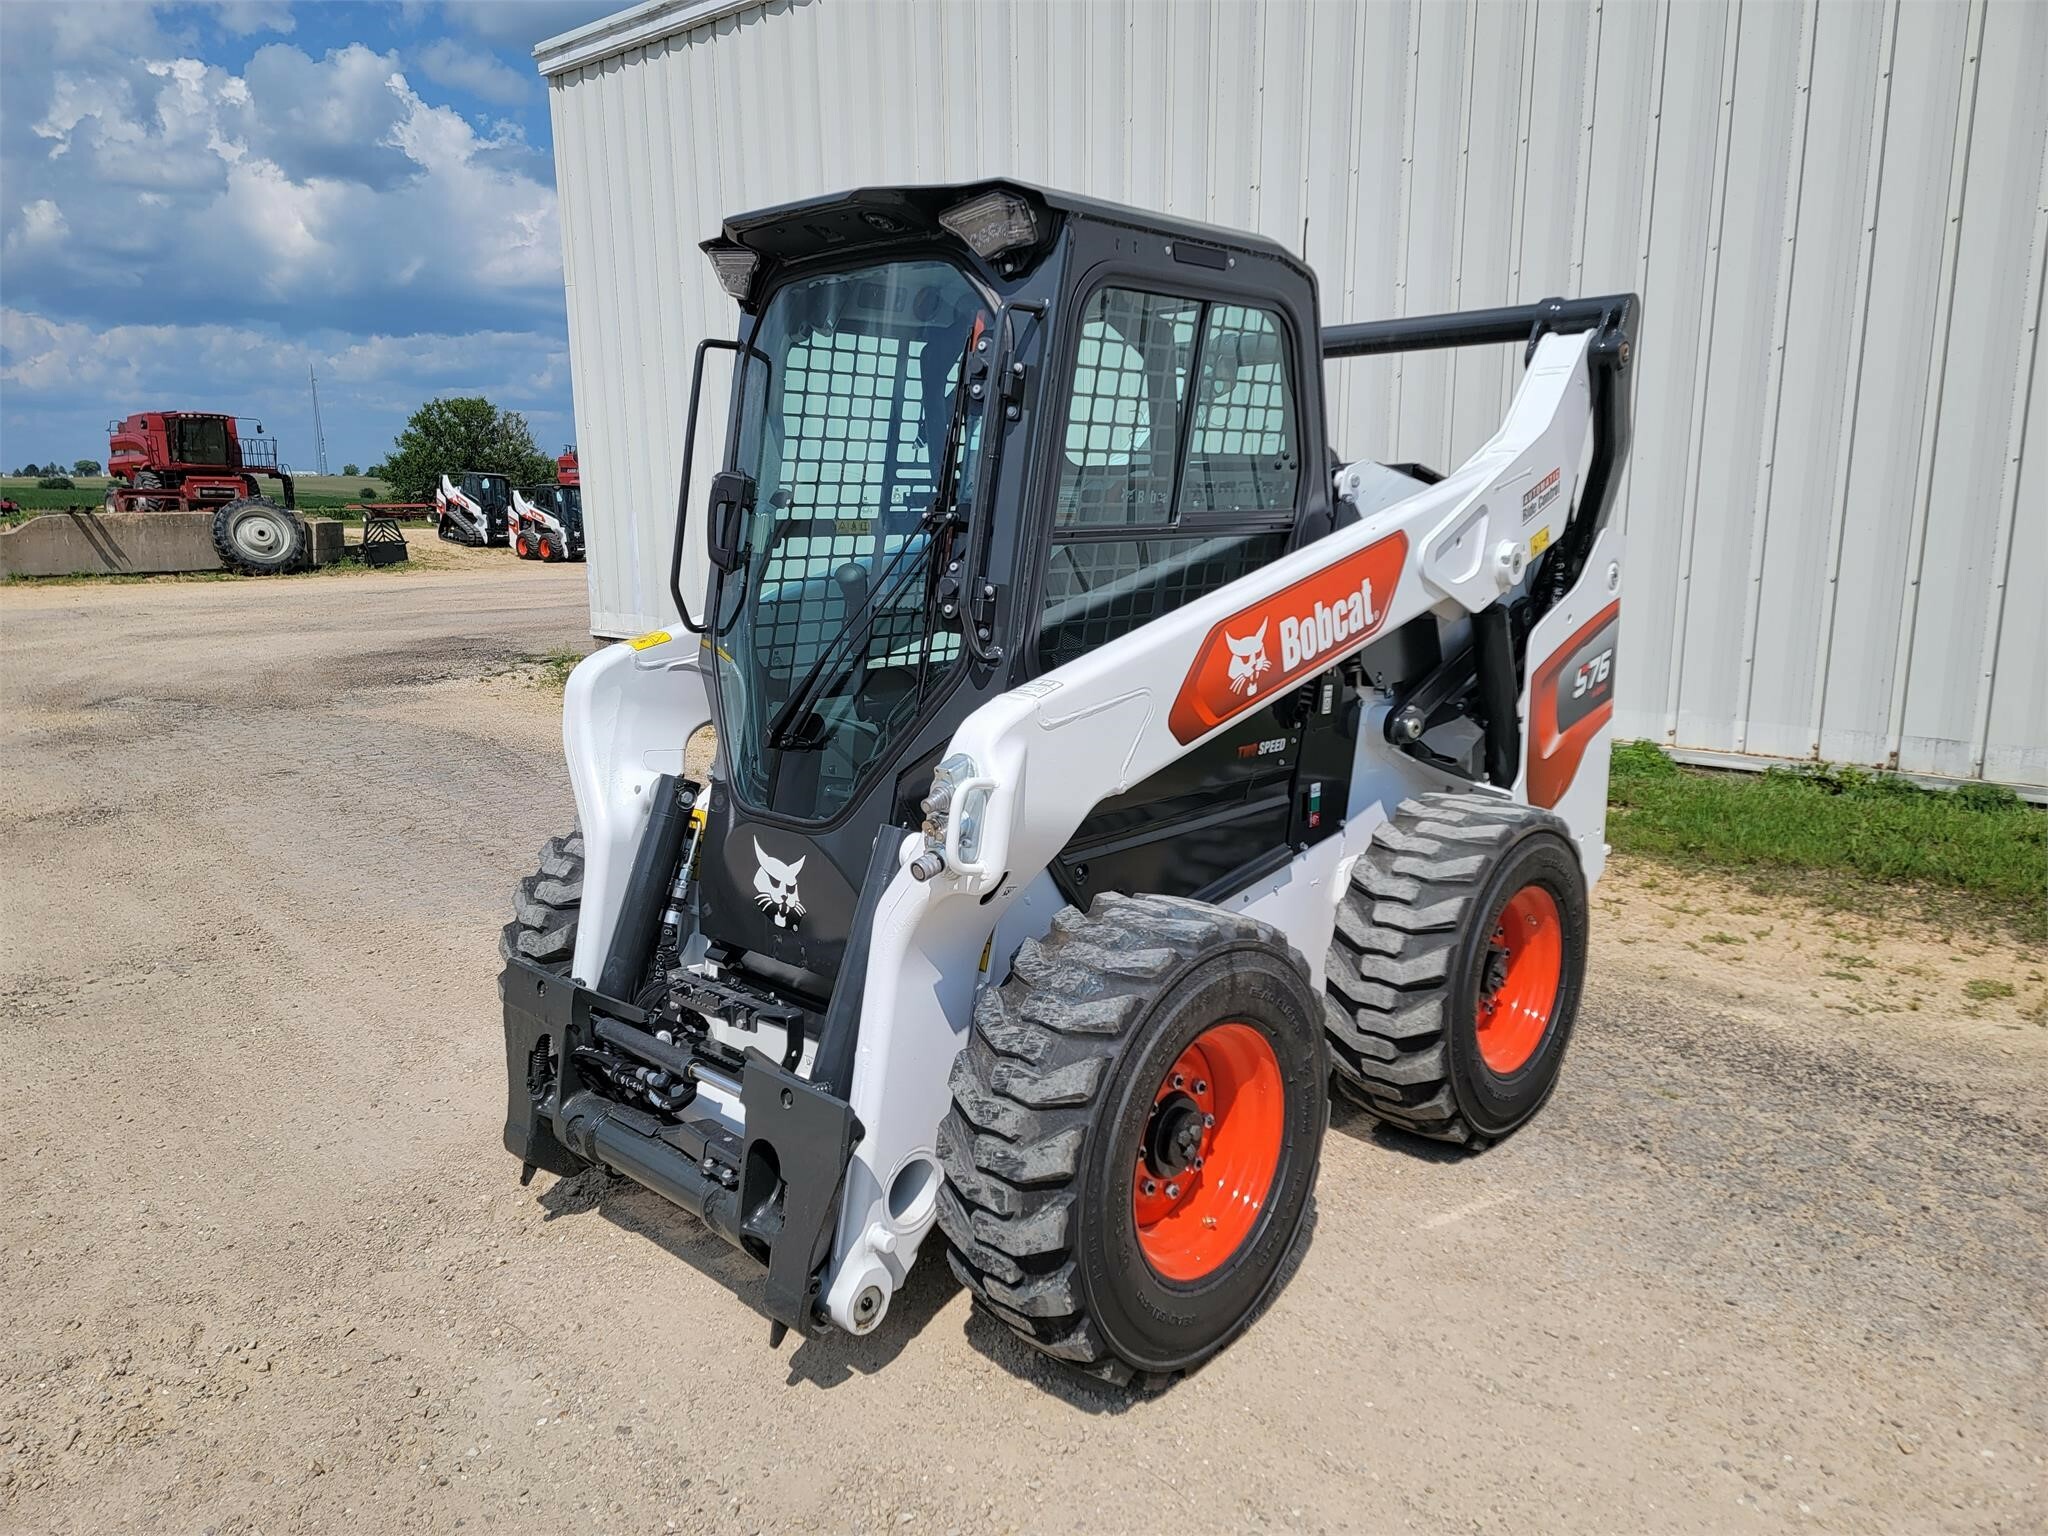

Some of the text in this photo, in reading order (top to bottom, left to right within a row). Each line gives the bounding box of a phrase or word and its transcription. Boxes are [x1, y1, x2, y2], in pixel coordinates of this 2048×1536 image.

[1522, 481, 1561, 522] Ride Control
[1523, 467, 1561, 507] AUTOMATIC
[1279, 577, 1374, 673] Bobcat
[1572, 648, 1613, 699] S76
[1257, 738, 1287, 756] SPEED
